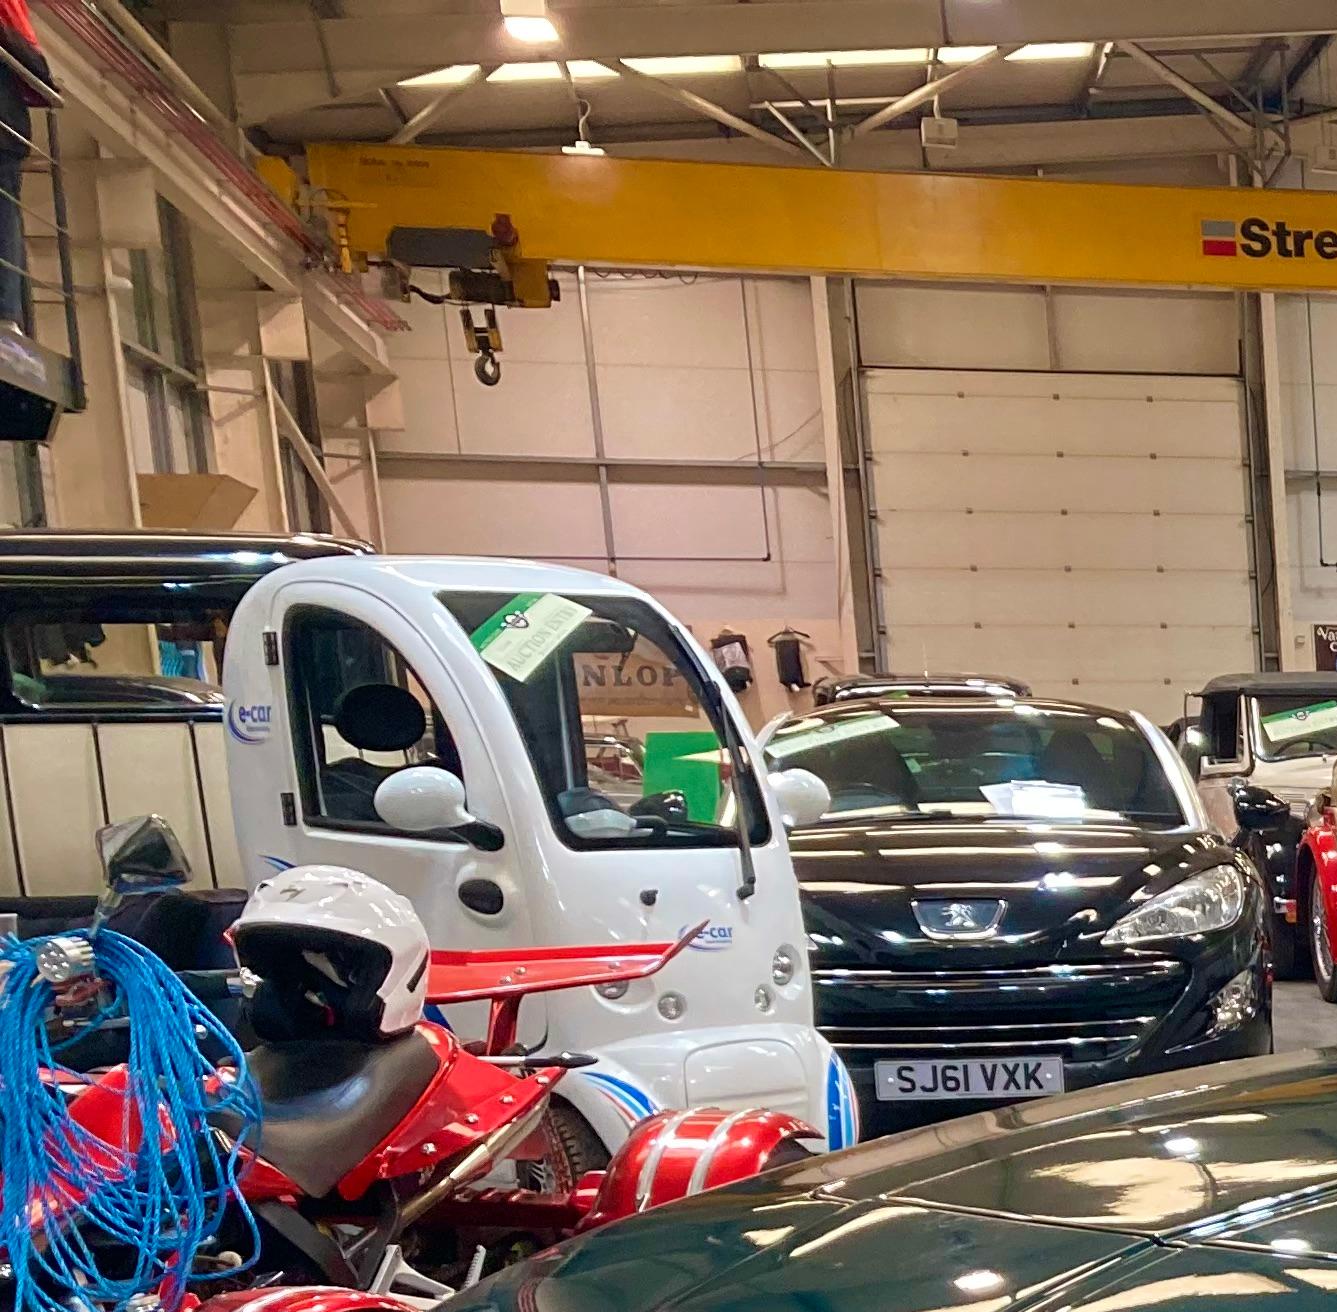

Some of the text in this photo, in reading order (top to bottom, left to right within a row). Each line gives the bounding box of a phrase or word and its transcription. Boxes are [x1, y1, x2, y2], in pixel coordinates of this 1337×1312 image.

[239, 705, 271, 723] e-car
[897, 1062, 1044, 1093] SJ61 VXK
